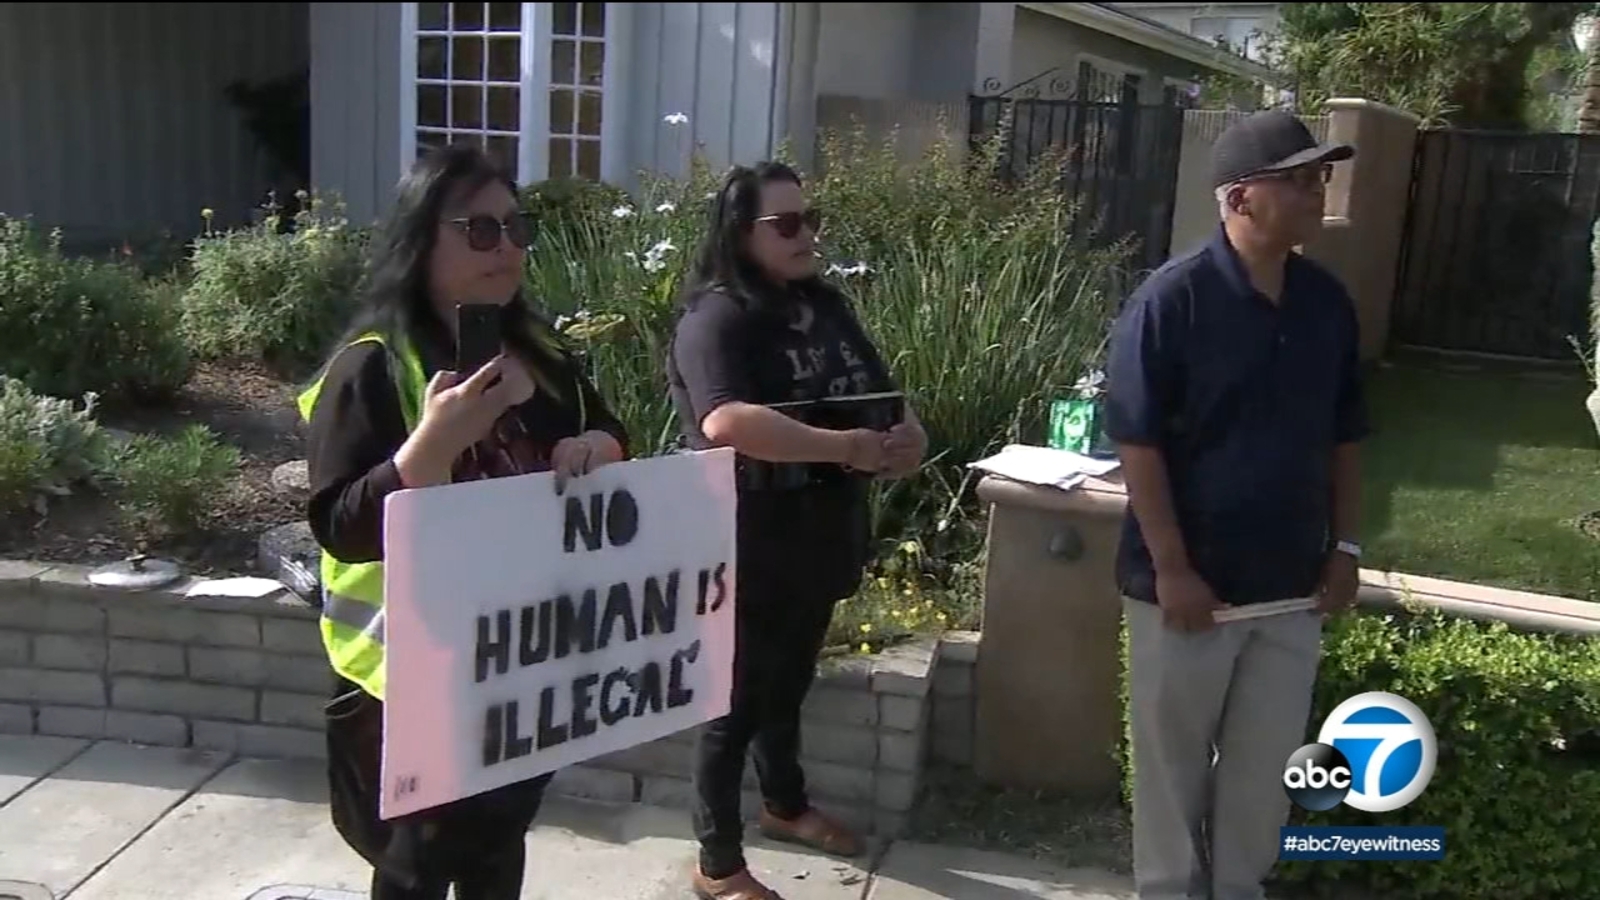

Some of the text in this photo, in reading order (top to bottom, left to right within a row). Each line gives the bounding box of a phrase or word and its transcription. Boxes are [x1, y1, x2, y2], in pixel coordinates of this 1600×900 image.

[563, 489, 639, 553] NO
[474, 561, 727, 683] HUMAN IS
[482, 639, 701, 768] ILLEGAL
